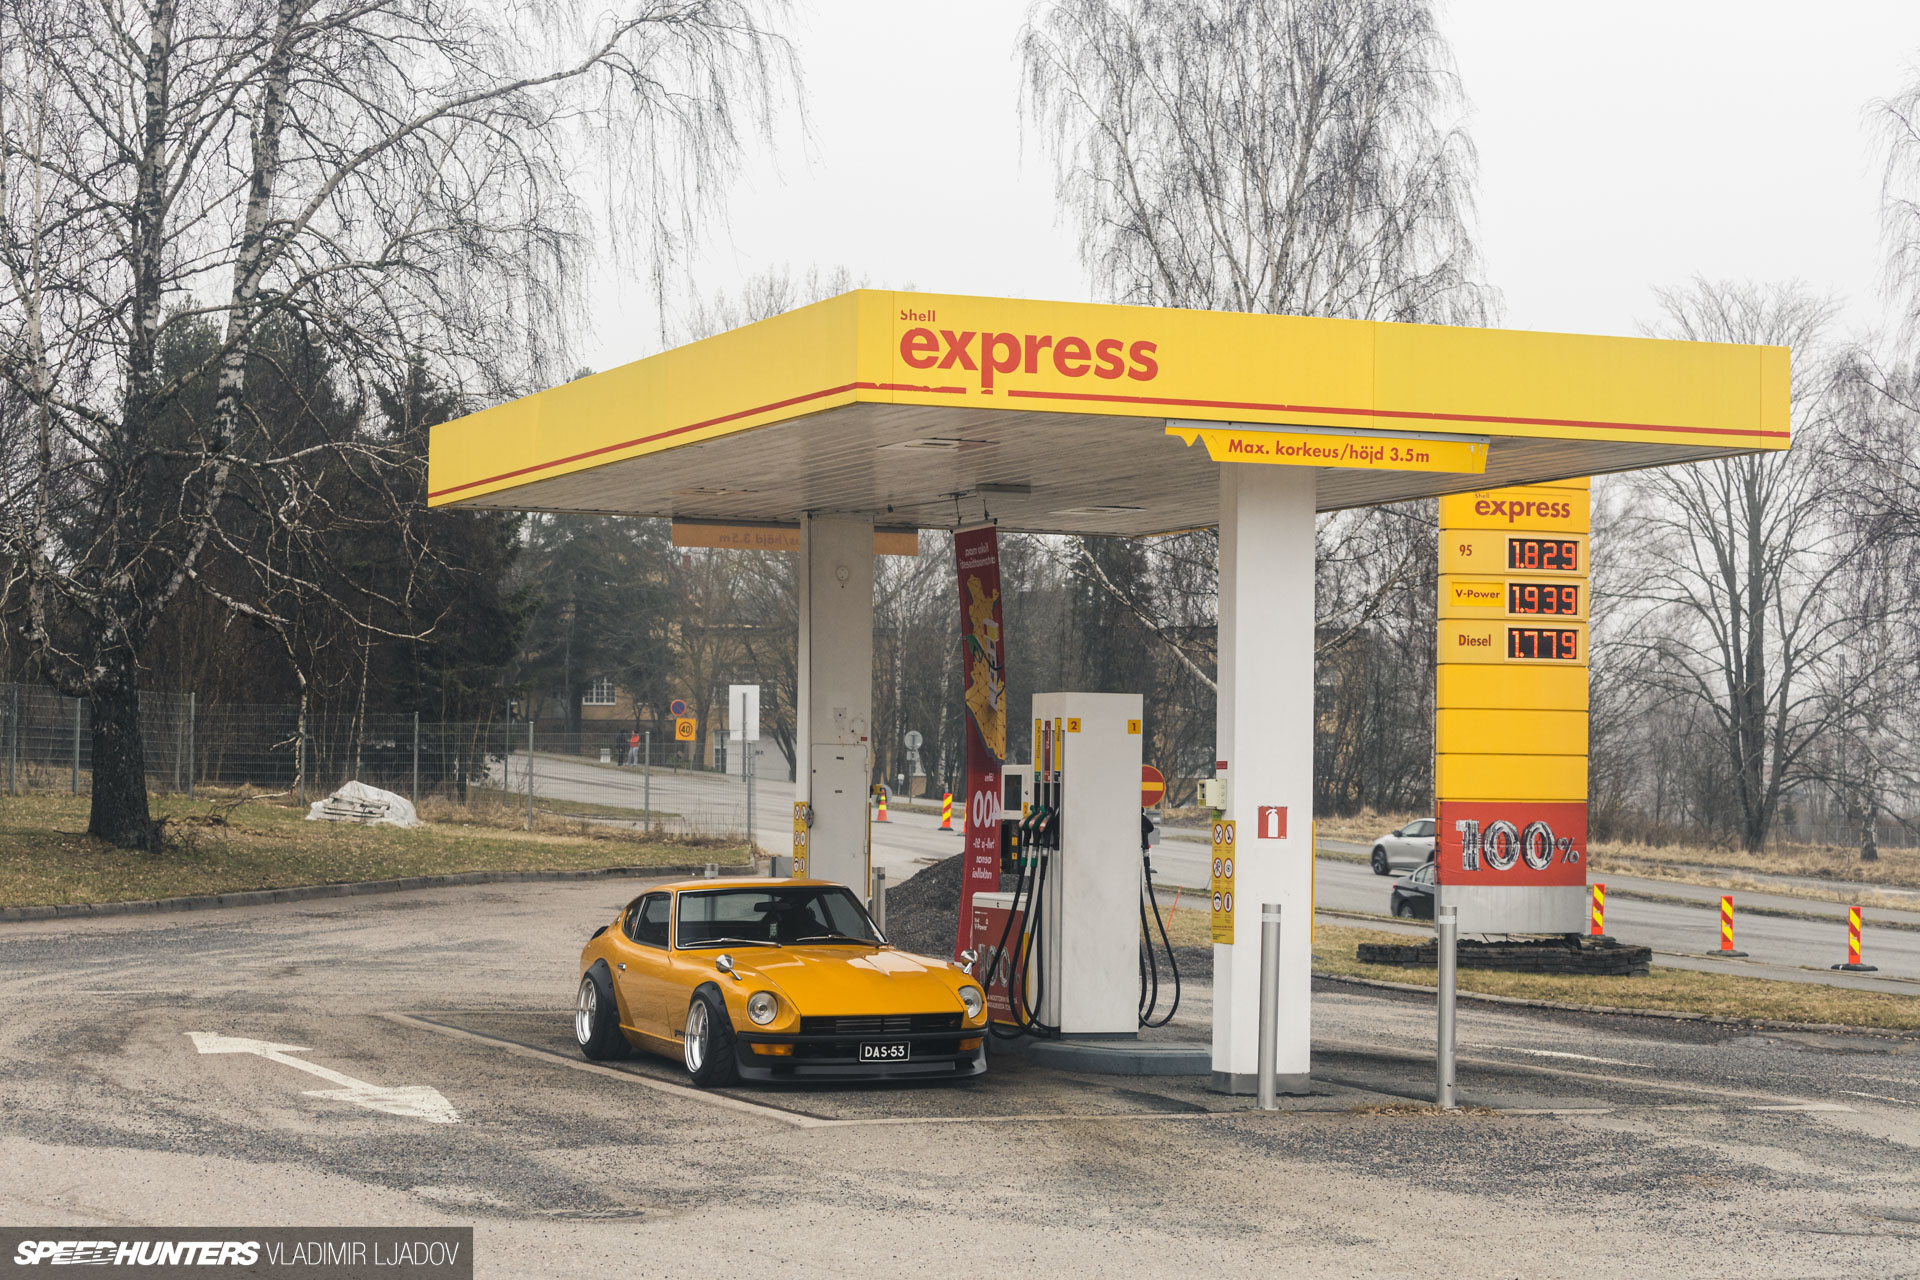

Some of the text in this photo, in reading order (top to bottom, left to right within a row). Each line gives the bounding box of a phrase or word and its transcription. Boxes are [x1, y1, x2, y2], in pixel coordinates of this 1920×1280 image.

[900, 309, 936, 322] Shell
[900, 327, 1159, 389] express
[1228, 439, 1430, 464] Max. korkeus/höjd 3.5m
[1475, 500, 1571, 523] express
[1459, 541, 1576, 569] 95 1.829
[1455, 586, 1576, 614] V-Power 1.939
[1458, 630, 1576, 659] Diesel 1.779
[680, 725, 690, 734] 40
[1071, 721, 1077, 730] 2
[1456, 819, 1580, 871] 100%
